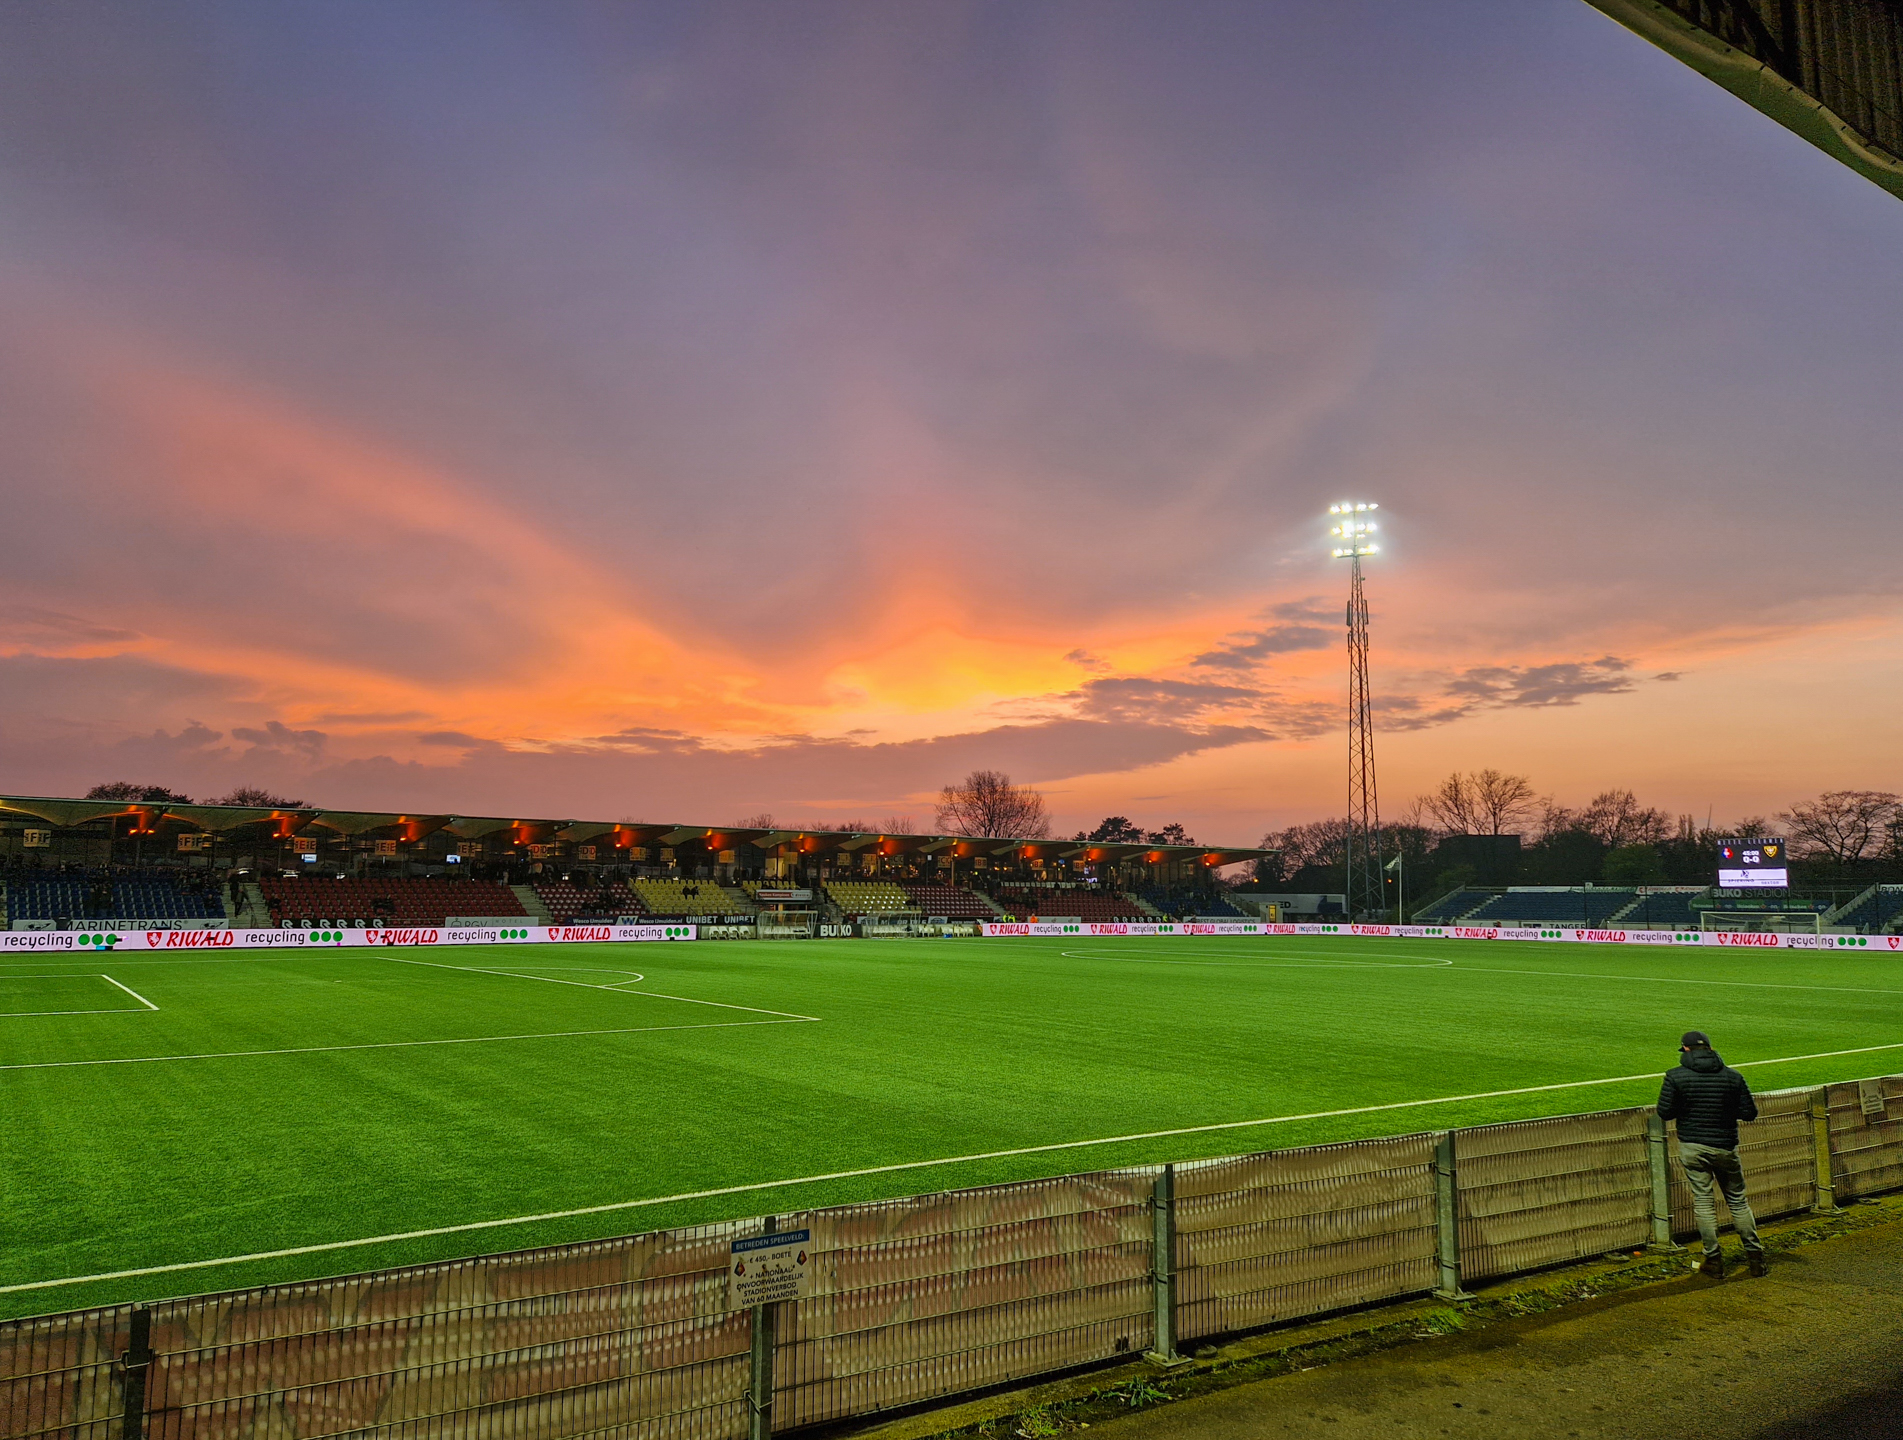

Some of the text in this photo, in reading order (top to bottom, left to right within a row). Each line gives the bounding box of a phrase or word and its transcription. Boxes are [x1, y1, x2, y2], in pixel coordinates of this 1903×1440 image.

[1745, 888, 1790, 898] STADION
[686, 915, 718, 924] UNIBET
[724, 915, 755, 924] UNIBET
[562, 926, 663, 942] RIWALD recycling
[999, 924, 1029, 935] RIWALD
[1099, 924, 1128, 935] RIWALD
[1191, 924, 1216, 934] RIWALD
[1273, 924, 1296, 934] RIWALD
[1361, 925, 1390, 936] RIWALD
[1464, 927, 1539, 940] RIWALD recycling
[4, 932, 73, 949] recycling
[166, 930, 305, 947] RIWALD recycling
[382, 928, 497, 945] RIWALD recycling
[1587, 930, 1673, 944] RIWALD recycling
[1731, 933, 1779, 947] RIWALD
[736, 1240, 768, 1250] BETREDEN
[772, 1251, 791, 1260] BOETE
[737, 1272, 803, 1290] ONVOORWAARDELIJK
[744, 1281, 796, 1297] STADIONVERBOD
[742, 1297, 755, 1305] VAN
[766, 1289, 798, 1301] MAANDEN
